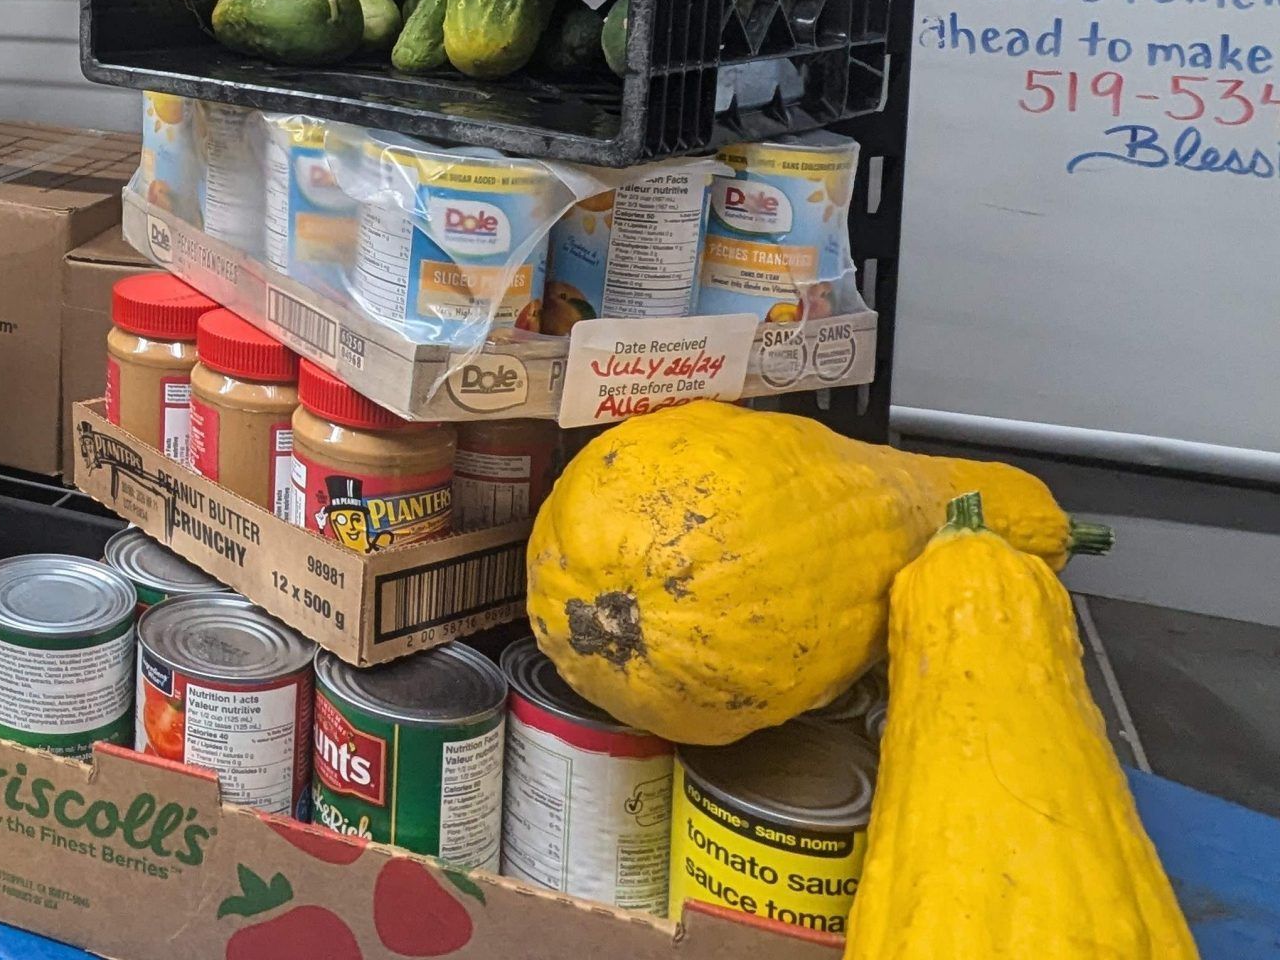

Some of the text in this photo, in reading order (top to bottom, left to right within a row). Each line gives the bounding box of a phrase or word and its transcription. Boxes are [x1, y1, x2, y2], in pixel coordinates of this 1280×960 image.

[919, 12, 1272, 75] ahead to make
[473, 174, 497, 185] ADDED
[652, 185, 689, 195] nutritive
[665, 174, 689, 185] Facts
[444, 206, 499, 234] Dole
[615, 336, 707, 355] Date Received
[763, 322, 853, 349] SANS SANS
[461, 364, 518, 394] Dole
[590, 354, 663, 379] JULY
[598, 376, 707, 398] Best Before Date
[94, 433, 144, 474] PLANTERS
[157, 468, 205, 515] PEANUT
[208, 496, 261, 546] BUTTER
[368, 486, 452, 530] PLANTERS
[171, 505, 249, 568] CRUNCHY
[307, 554, 347, 590] 98981
[271, 570, 347, 632] 12 x 500 g
[189, 687, 230, 703] Nutrition
[189, 698, 261, 715] Valeur nutritive
[187, 726, 229, 741] Calories 40
[445, 740, 483, 755] Nutrition
[445, 753, 474, 766] Valeur
[687, 784, 700, 804] no
[754, 823, 797, 847] sans
[7, 816, 37, 839] the
[40, 826, 97, 858] Finest
[686, 816, 779, 886] tomato
[685, 855, 758, 915] sauce
